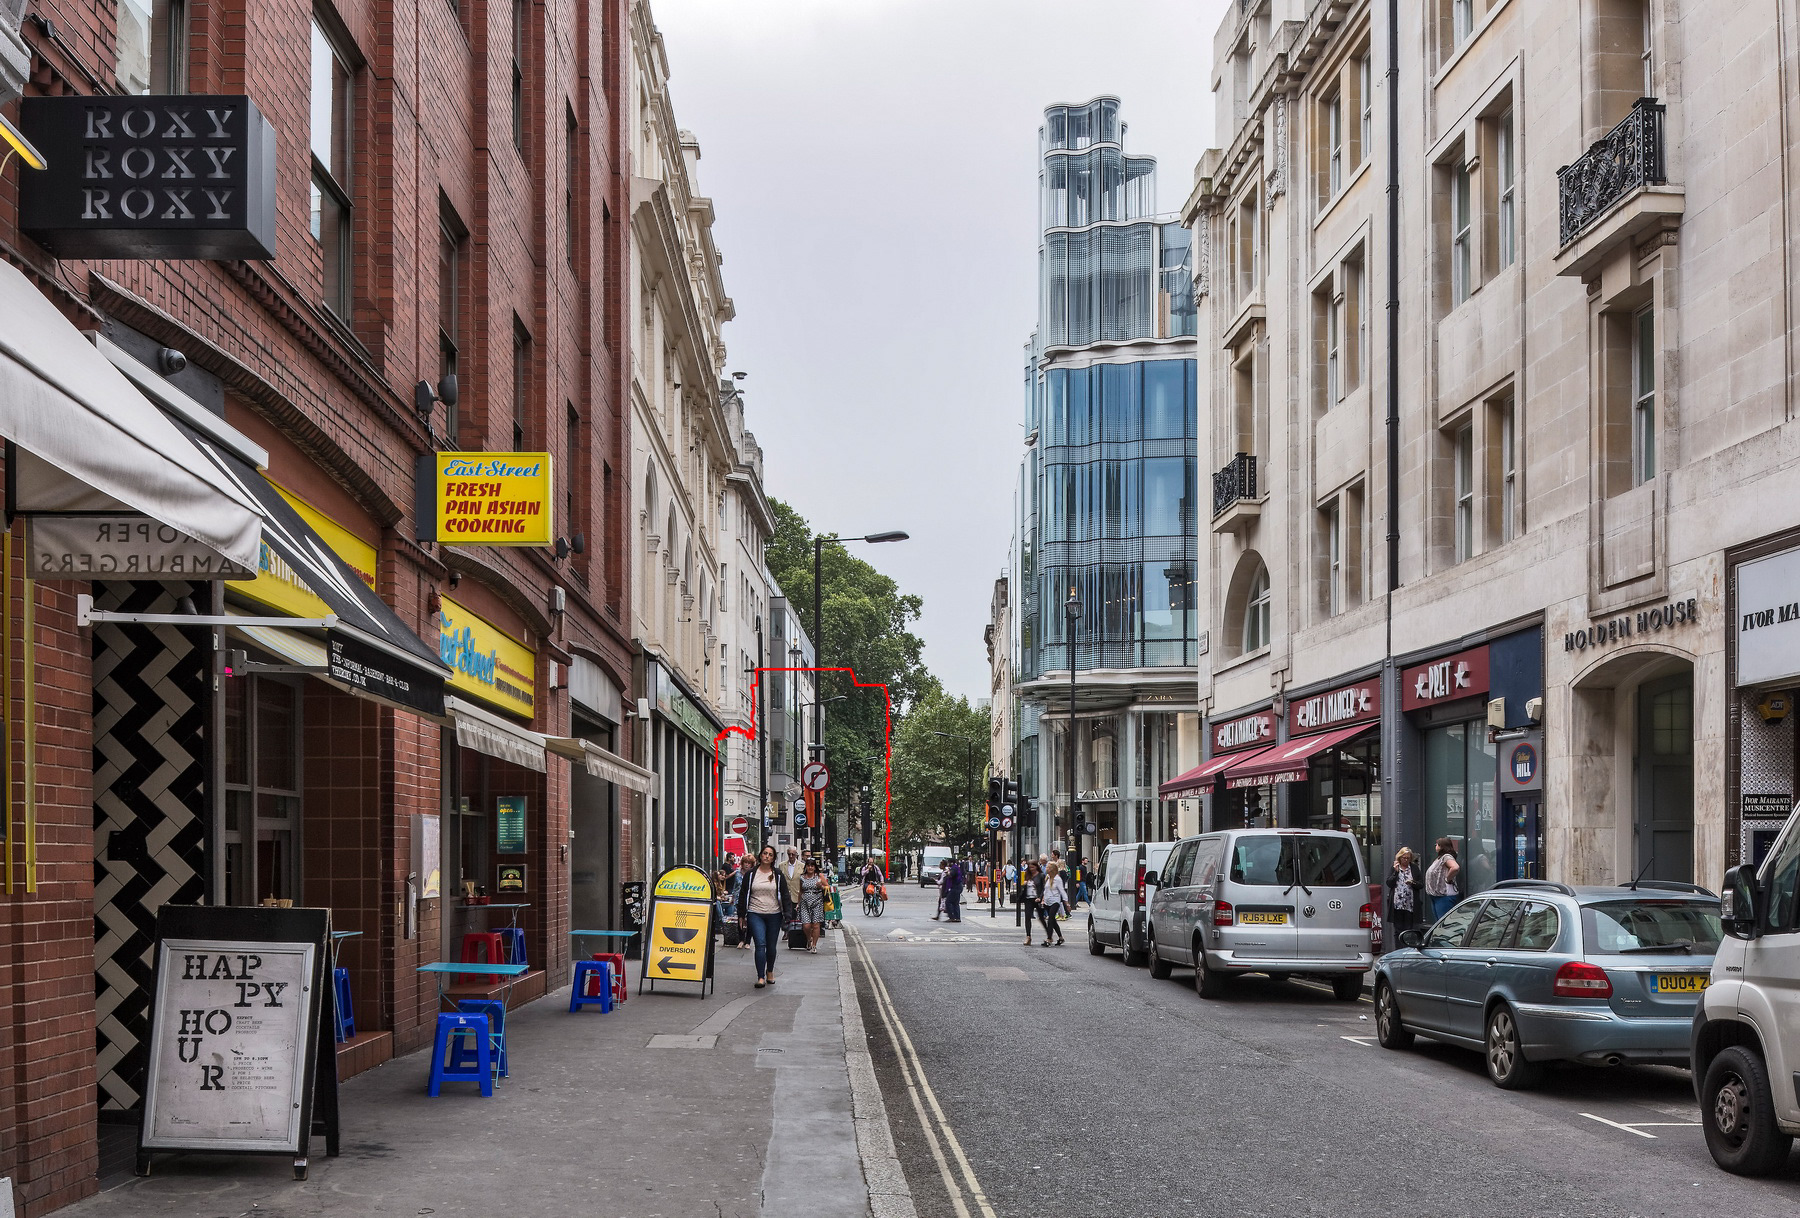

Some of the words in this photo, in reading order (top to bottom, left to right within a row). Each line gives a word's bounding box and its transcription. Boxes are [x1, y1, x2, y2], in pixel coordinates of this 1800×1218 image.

[84, 104, 238, 139] ROXY
[83, 145, 237, 179] ROXY
[81, 186, 237, 220] ROXY
[443, 459, 483, 477] East
[484, 460, 541, 477] Street
[445, 482, 502, 497] FRESH
[445, 500, 483, 515] PAN
[486, 500, 541, 516] ASIAN
[445, 518, 526, 533] COOKING
[1565, 616, 1631, 652] HOLDEN
[1637, 598, 1698, 634] HOUSE
[1741, 608, 1775, 632] IVOR
[1428, 661, 1451, 700] PRET
[1305, 697, 1321, 728] PRET
[1321, 696, 1327, 725] A
[1327, 688, 1357, 723] MANGER
[1770, 701, 1785, 710] ADT
[1223, 722, 1234, 748] PRET
[1238, 716, 1259, 745] MANGER
[1516, 762, 1532, 778] HILL
[1078, 788, 1119, 800] ZARA
[658, 880, 677, 889] East
[677, 881, 706, 892] Street
[1242, 913, 1265, 922] RJ63
[1267, 914, 1284, 922] LXE
[1328, 901, 1342, 910] GB
[659, 946, 696, 954] DIVERSION
[182, 954, 262, 980] HAP
[234, 982, 289, 1008] PY
[1660, 976, 1696, 990] OU04
[178, 1009, 232, 1035] HO
[178, 1036, 203, 1063] U
[200, 1065, 226, 1091] R
